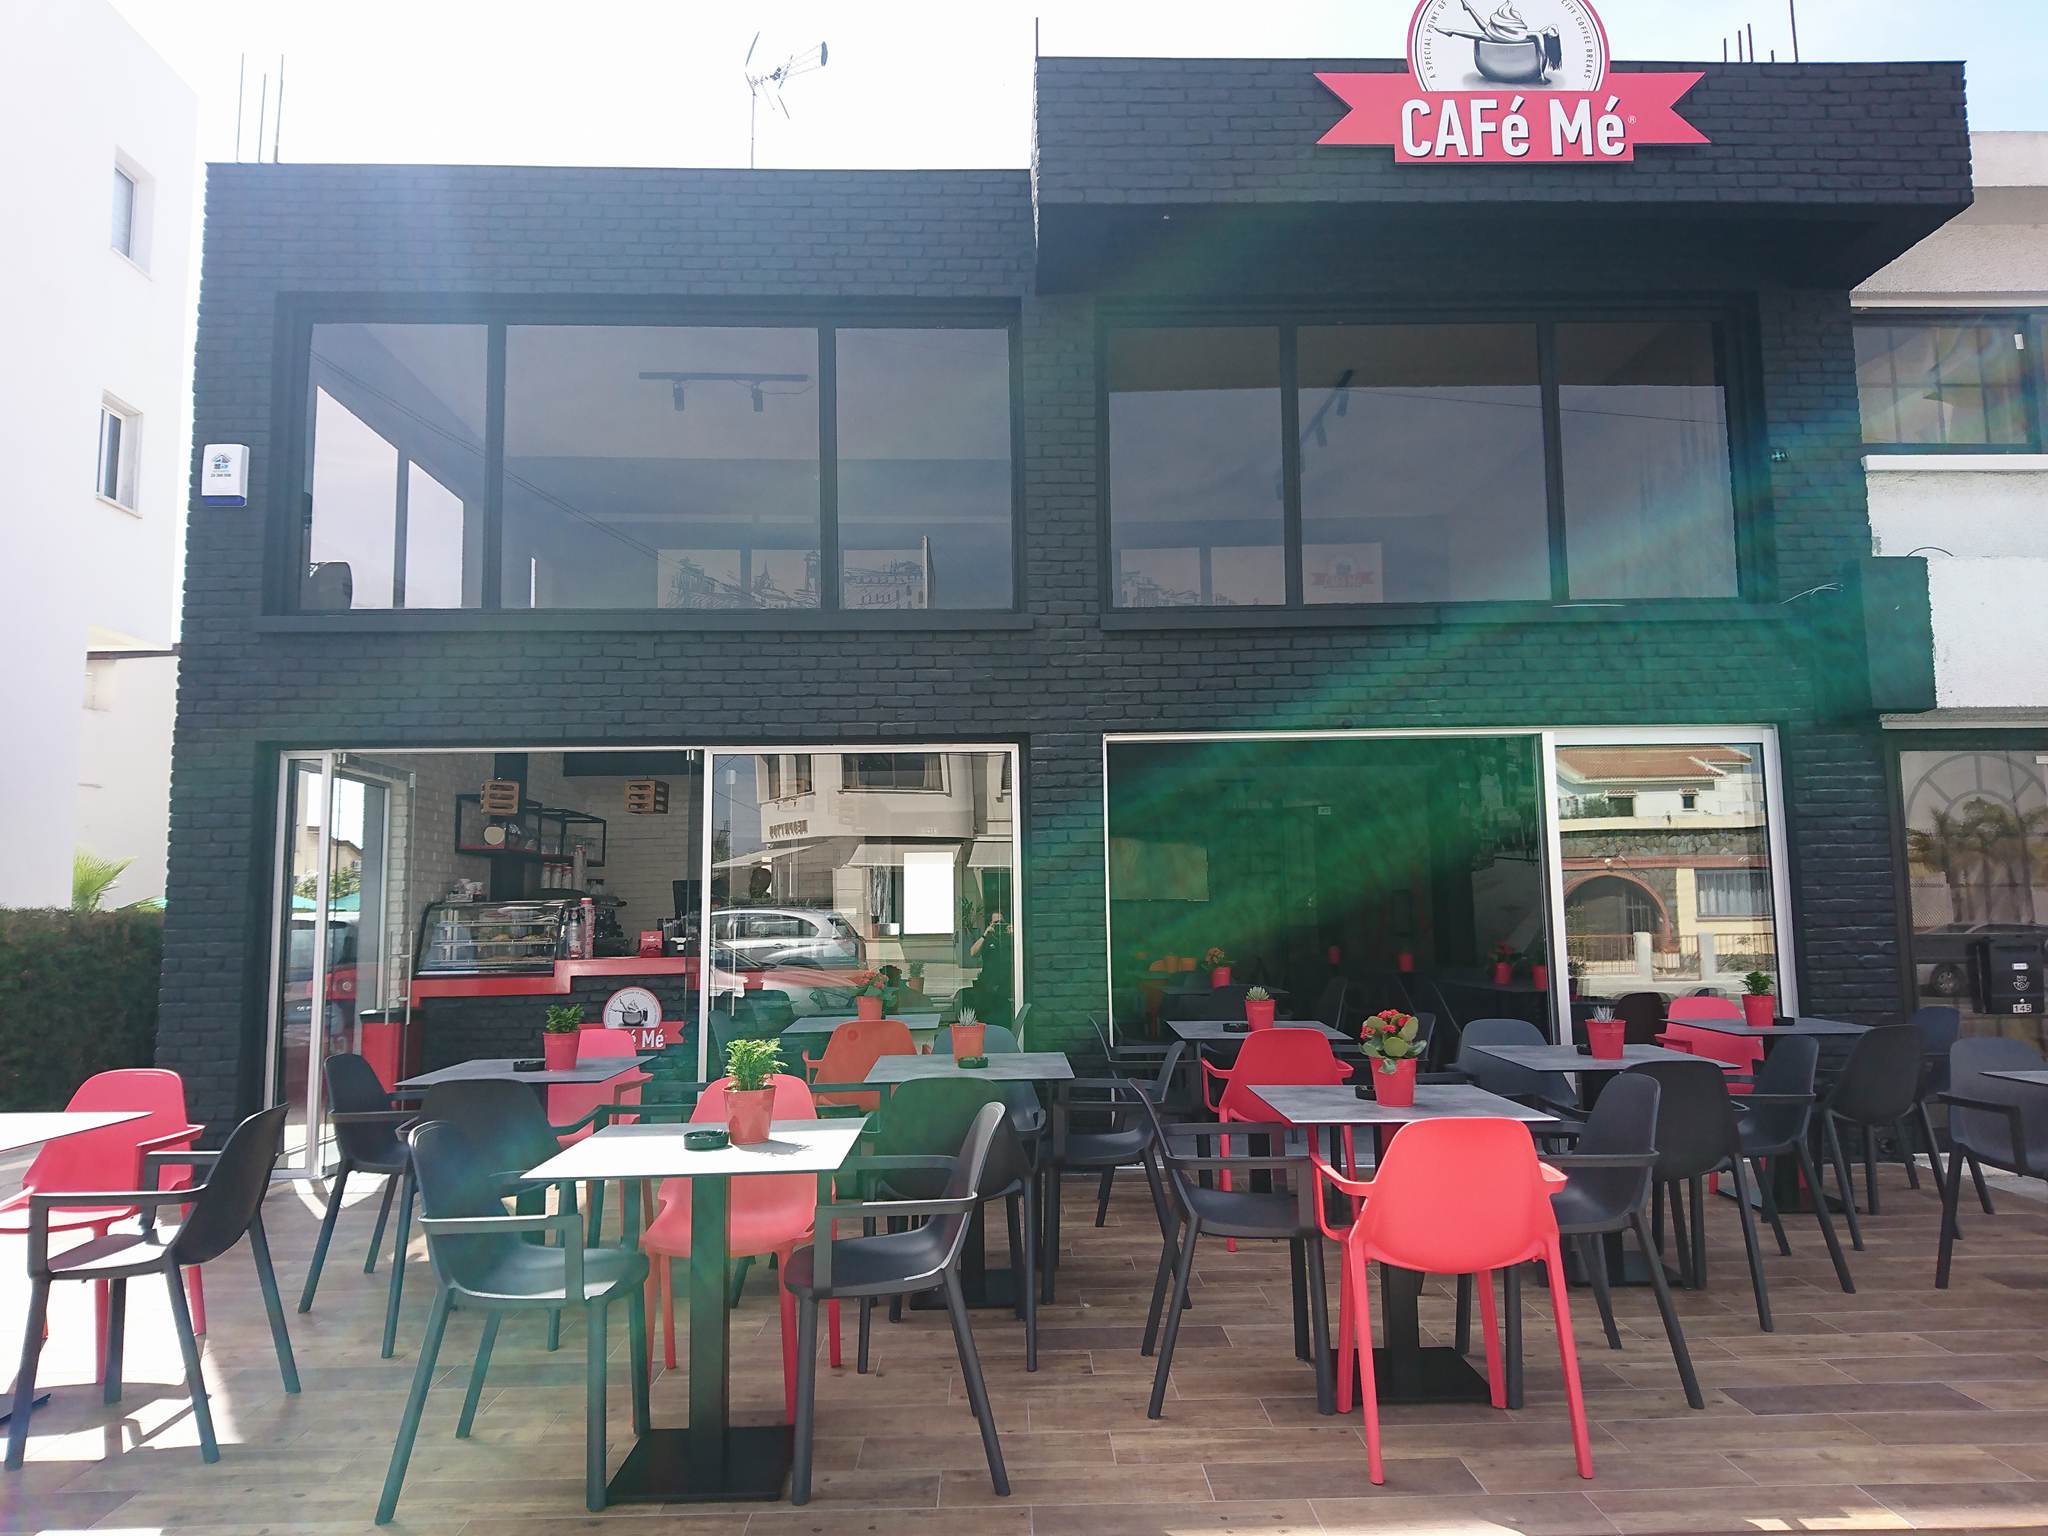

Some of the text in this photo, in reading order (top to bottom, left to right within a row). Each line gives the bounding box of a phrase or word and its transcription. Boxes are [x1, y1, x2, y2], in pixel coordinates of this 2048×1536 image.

[1425, 11, 1440, 33] POINT
[1423, 38, 1434, 71] SPECIAL
[1575, 16, 1592, 45] COFFEE
[1584, 48, 1594, 79] BREAKS
[1401, 95, 1530, 157] CAFé
[2014, 1004, 2031, 1012] 145
[641, 1028, 664, 1048] Mé
